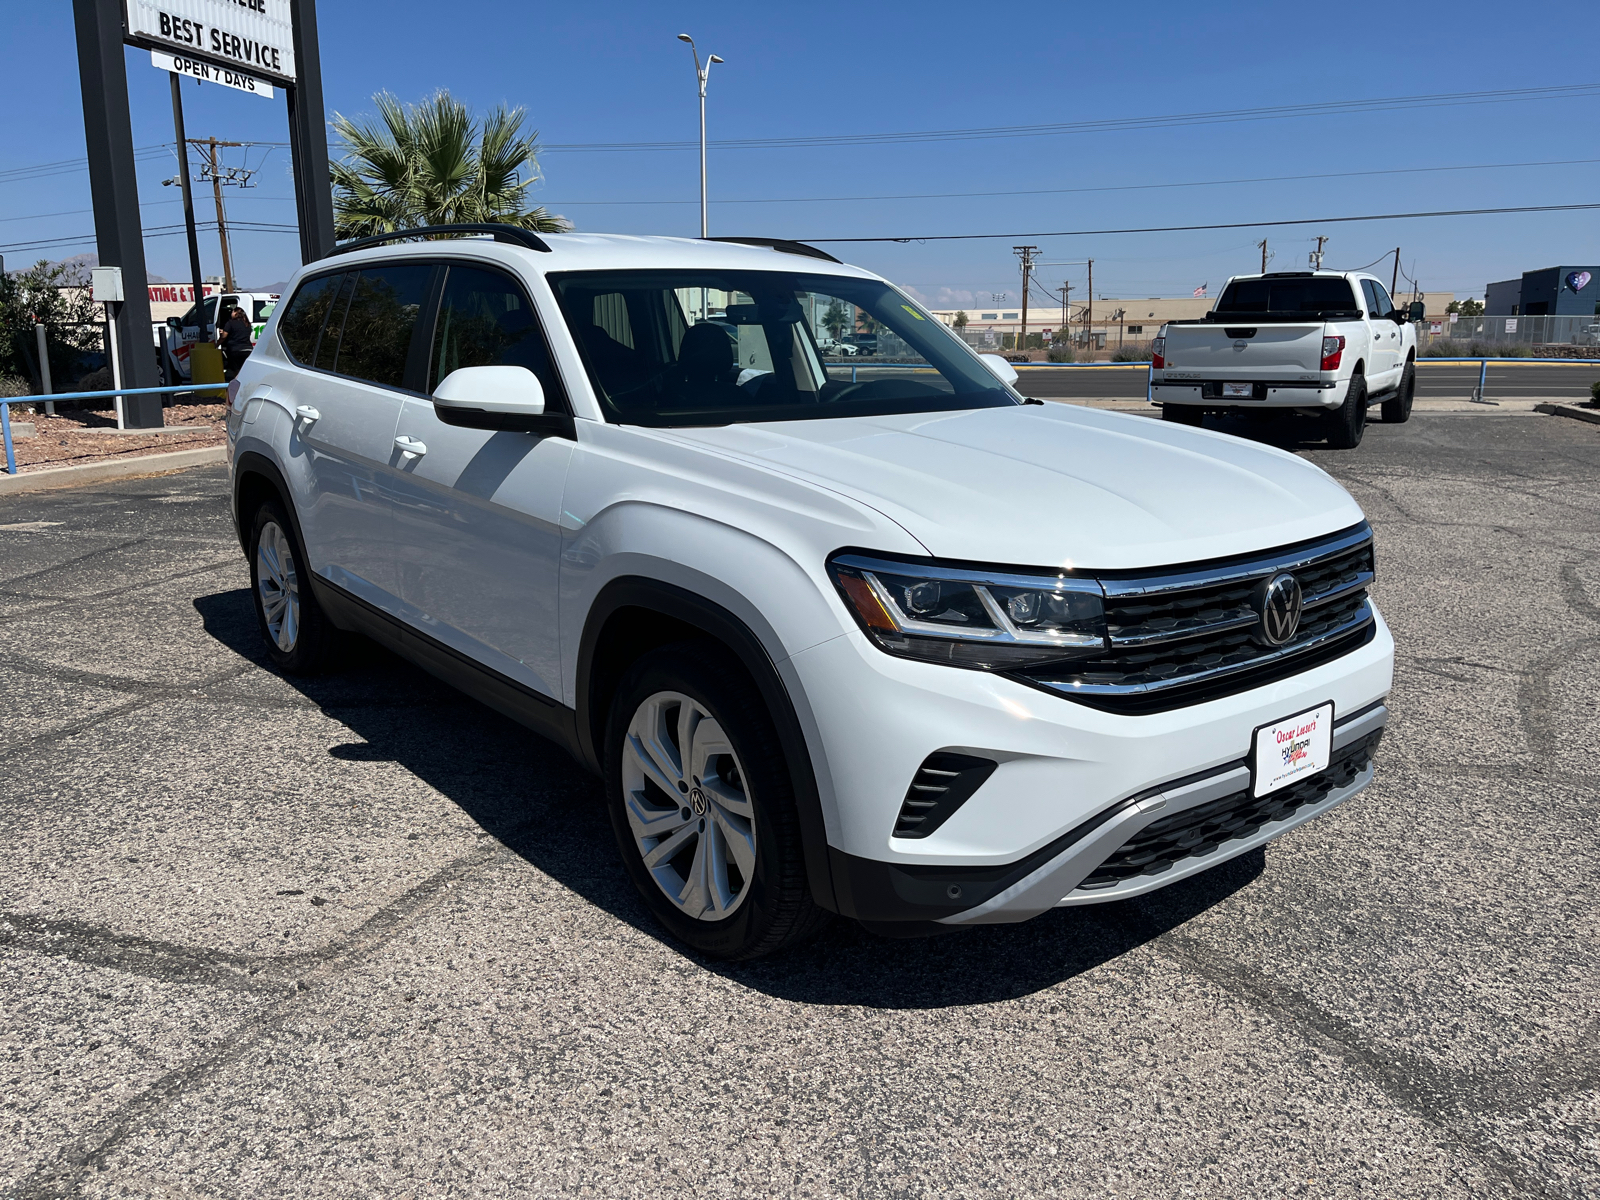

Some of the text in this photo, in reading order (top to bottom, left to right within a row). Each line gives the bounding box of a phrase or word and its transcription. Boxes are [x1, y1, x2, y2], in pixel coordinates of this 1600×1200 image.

[159, 12, 281, 71] BEST SERVICE
[173, 57, 255, 91] OPEN 7 DAYS
[148, 287, 177, 302] ATING
[180, 287, 187, 302] &
[1276, 729, 1296, 744] Oscar
